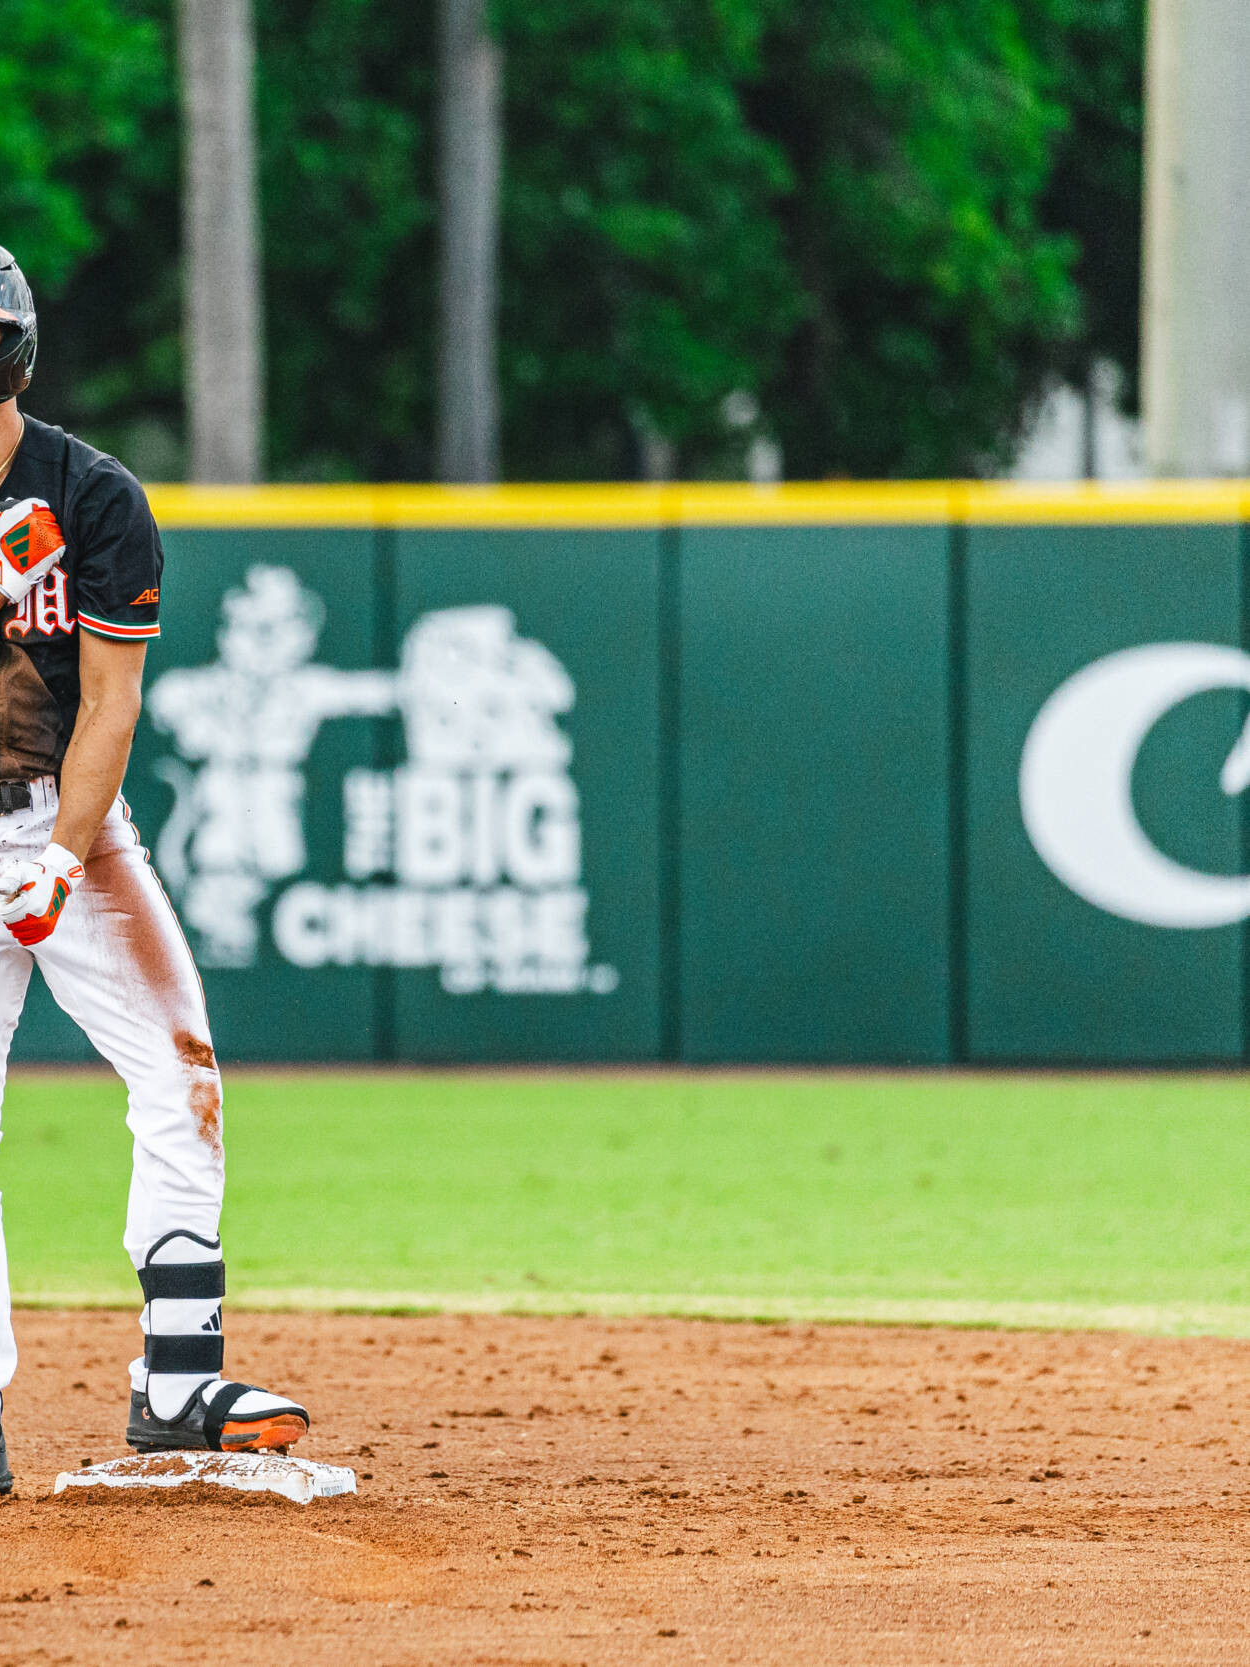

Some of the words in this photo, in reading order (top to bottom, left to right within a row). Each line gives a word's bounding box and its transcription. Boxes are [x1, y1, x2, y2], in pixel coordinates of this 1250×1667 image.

[4, 566, 77, 639] M
[395, 772, 581, 889] BIG
[272, 881, 590, 969] CHEESE
